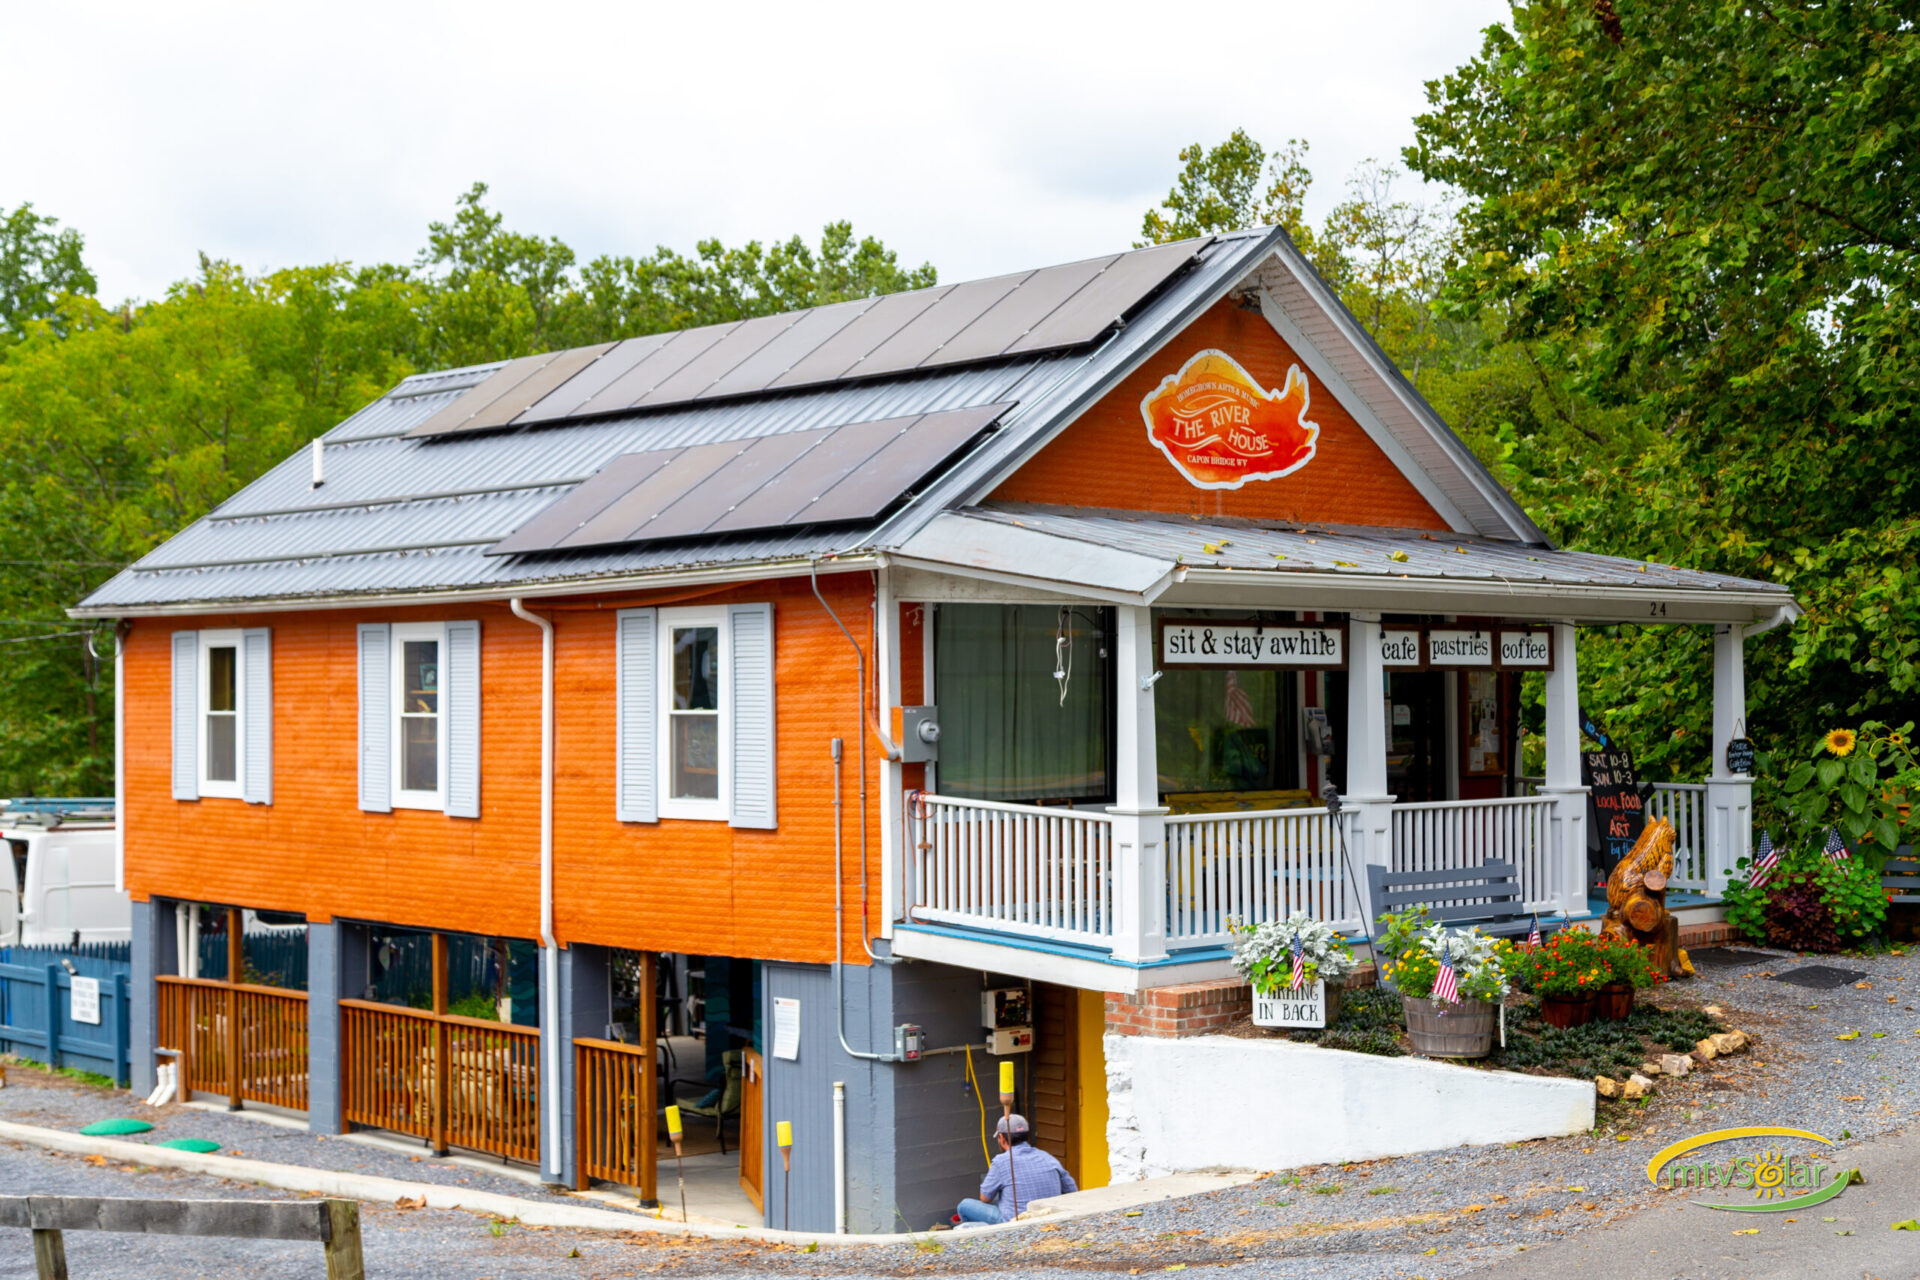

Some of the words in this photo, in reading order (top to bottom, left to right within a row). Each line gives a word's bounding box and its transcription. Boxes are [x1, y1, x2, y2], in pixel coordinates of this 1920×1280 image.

[1177, 382, 1217, 402] HOMEGROWN
[1218, 383, 1236, 394] ARTS
[1241, 390, 1260, 408] MUSIC
[1173, 417, 1205, 439] THE
[1209, 405, 1250, 428] RIVER
[1228, 428, 1269, 451] HOUSE
[1187, 455, 1210, 465] CAPON
[1210, 456, 1235, 466] BRIDGE
[1237, 458, 1248, 467] WV
[1650, 602, 1666, 616] 24
[1170, 629, 1196, 654] sit
[1201, 628, 1218, 654] &
[1223, 630, 1265, 660] stay
[1270, 630, 1336, 656] awhile
[1382, 637, 1417, 660] cafe
[1431, 635, 1488, 660] pastries
[1502, 637, 1547, 660] coffee
[1609, 752, 1630, 769] 10-8
[1613, 770, 1633, 785] 10-3
[1596, 795, 1621, 810] LOCAL
[1609, 819, 1630, 838] ART
[1610, 842, 1620, 860] by
[1259, 1003, 1273, 1019] IN
[1282, 1003, 1319, 1021] BACK
